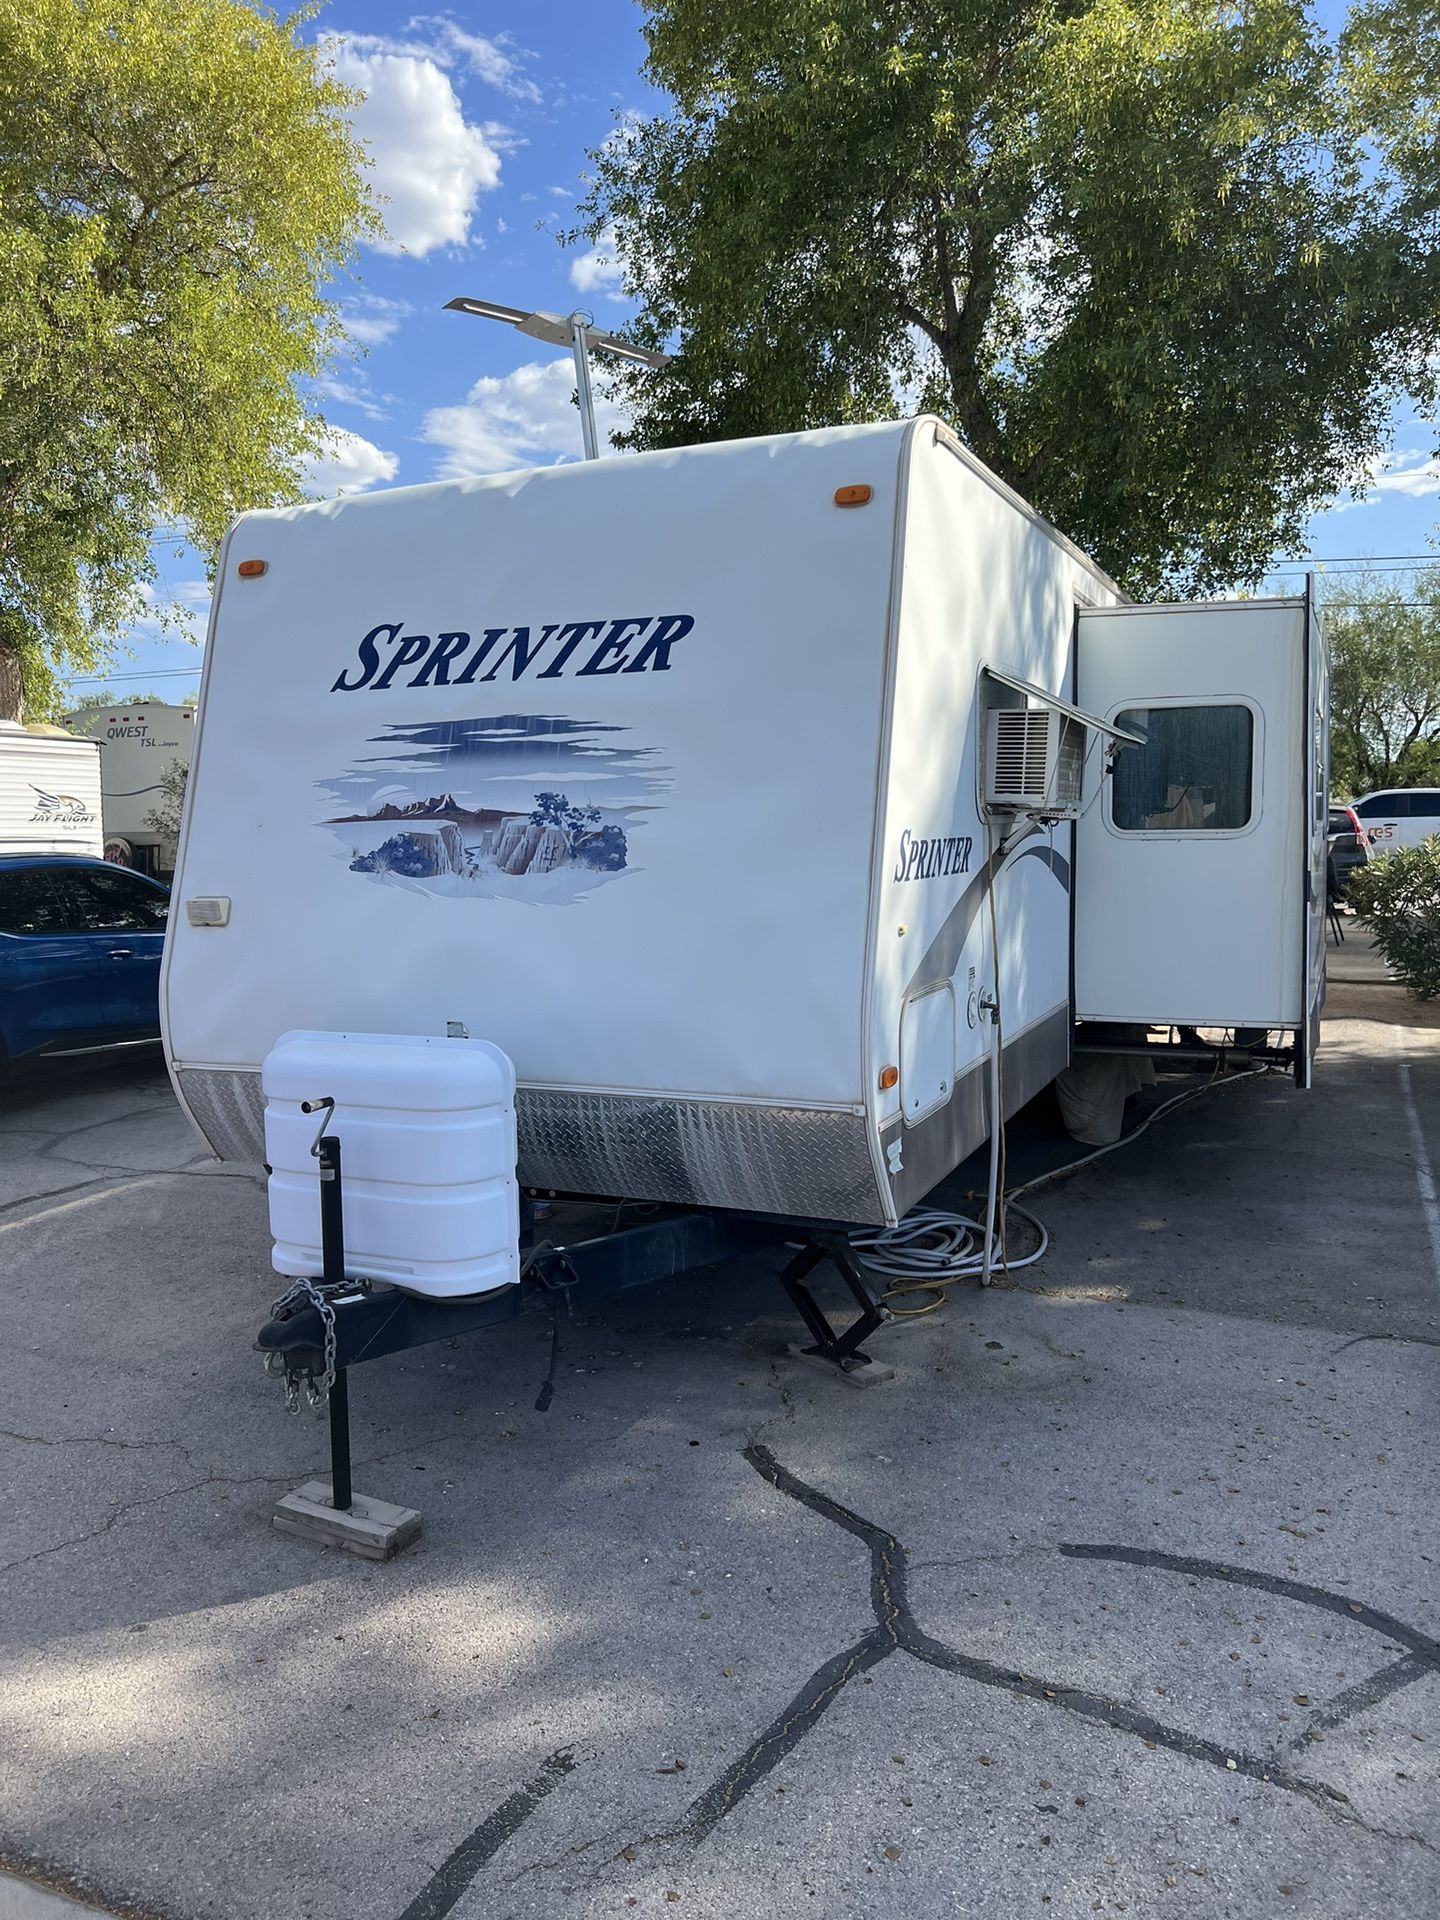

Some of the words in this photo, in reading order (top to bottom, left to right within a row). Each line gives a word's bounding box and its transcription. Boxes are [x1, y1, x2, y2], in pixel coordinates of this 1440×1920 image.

[107, 726, 148, 740] QWEST
[141, 738, 156, 747] TSL
[29, 813, 51, 822] JAY
[54, 814, 96, 823] FLIGHT
